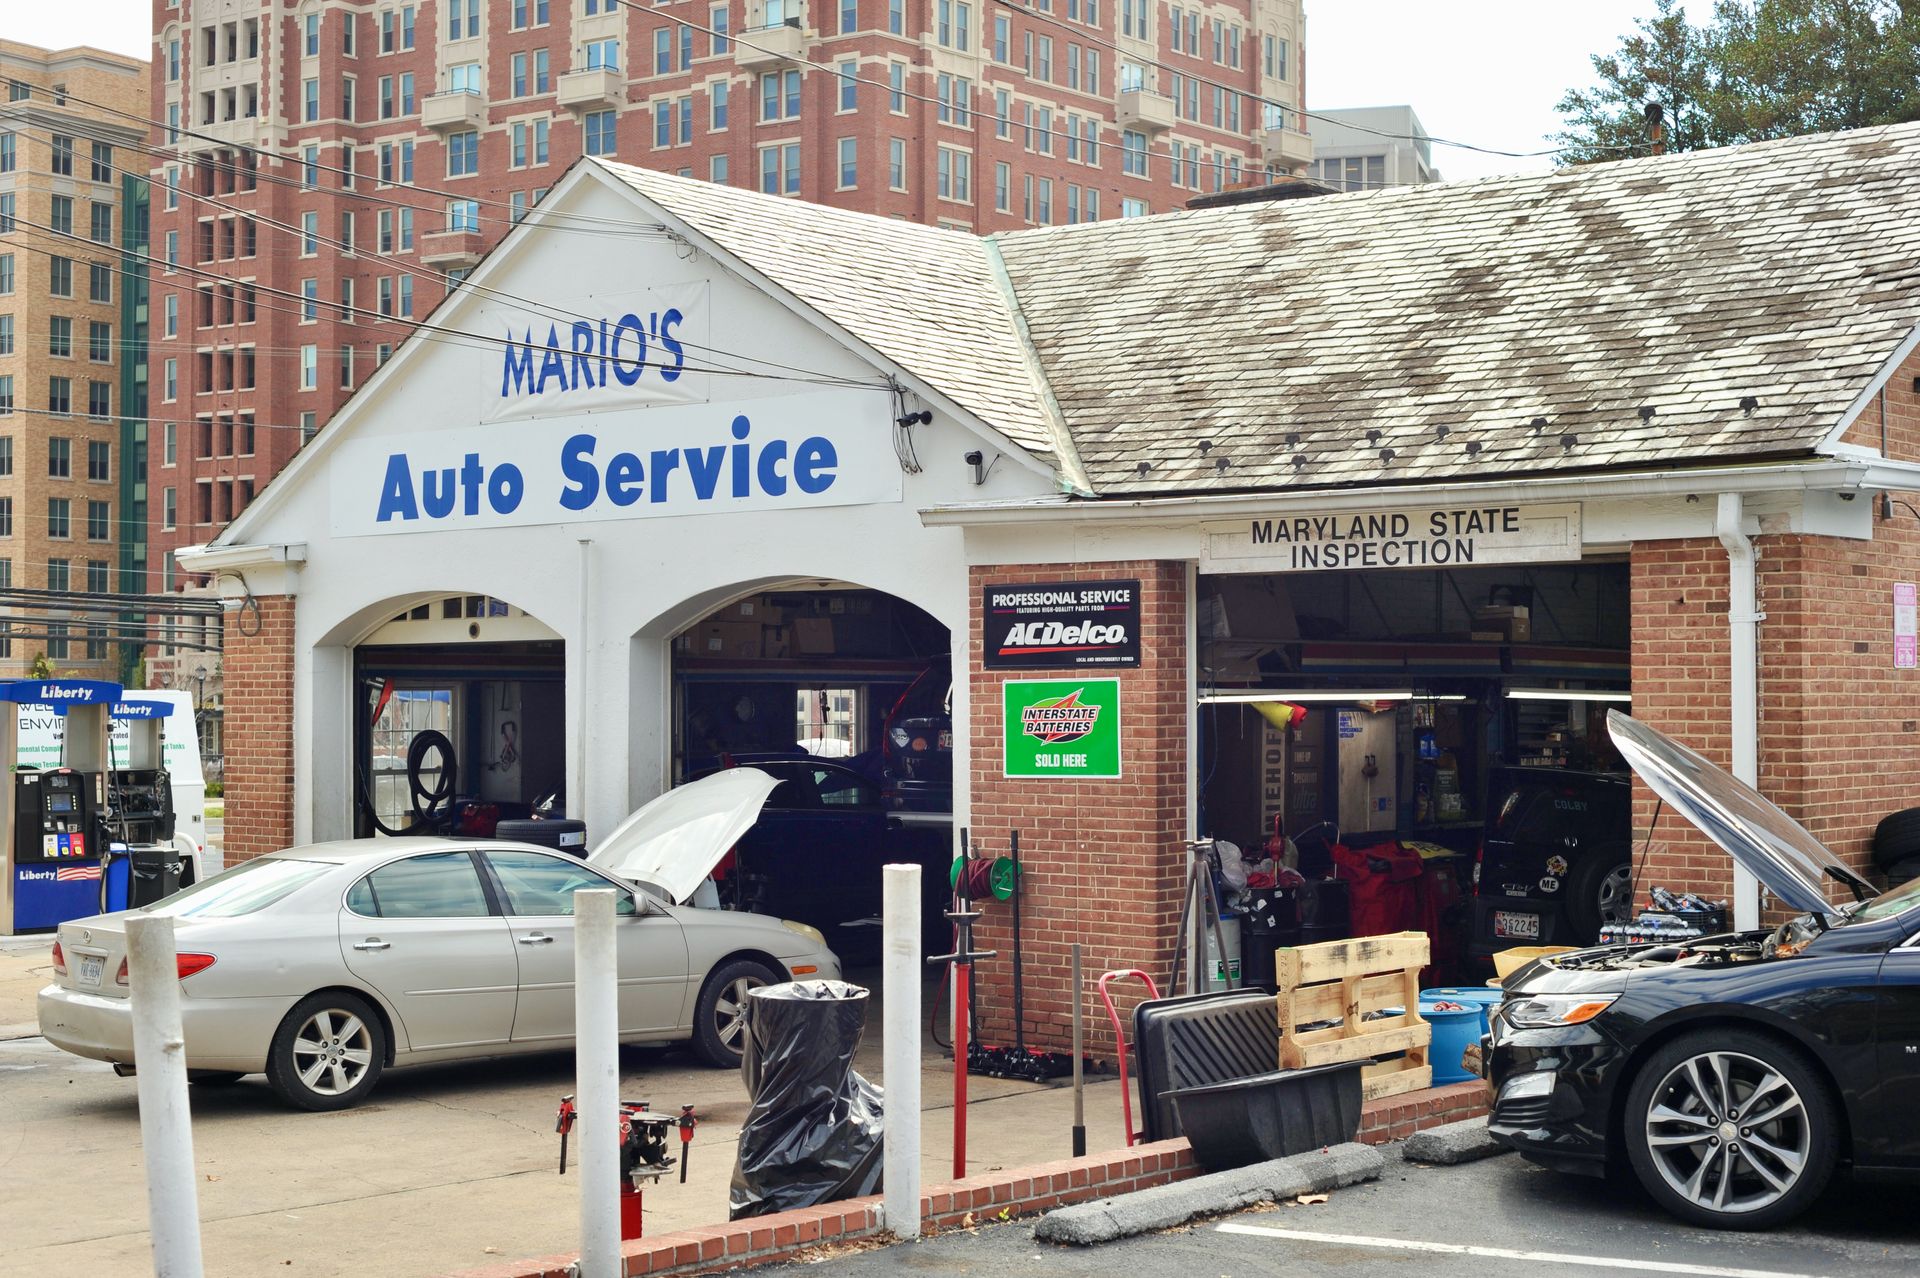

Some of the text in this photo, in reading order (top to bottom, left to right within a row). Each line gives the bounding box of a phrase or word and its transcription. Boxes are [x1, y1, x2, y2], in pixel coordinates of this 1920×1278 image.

[502, 308, 684, 398] MARIO'S
[376, 415, 838, 522] Auto Service
[1251, 507, 1520, 544] MARYLAND STATE
[1291, 538, 1474, 568] INSPECTION
[992, 589, 1130, 607] PROFESSIONAL SERVICE
[1090, 604, 1105, 612] FROM
[1003, 620, 1126, 646] ACDelco
[40, 685, 93, 700] Liberty
[113, 703, 152, 716] Liberty
[1023, 708, 1096, 720] INTERSTATE
[1026, 722, 1091, 732] BATTERIES
[1035, 753, 1087, 767] SOLD HERE
[20, 870, 55, 880] Liberty
[1541, 879, 1556, 889] ME
